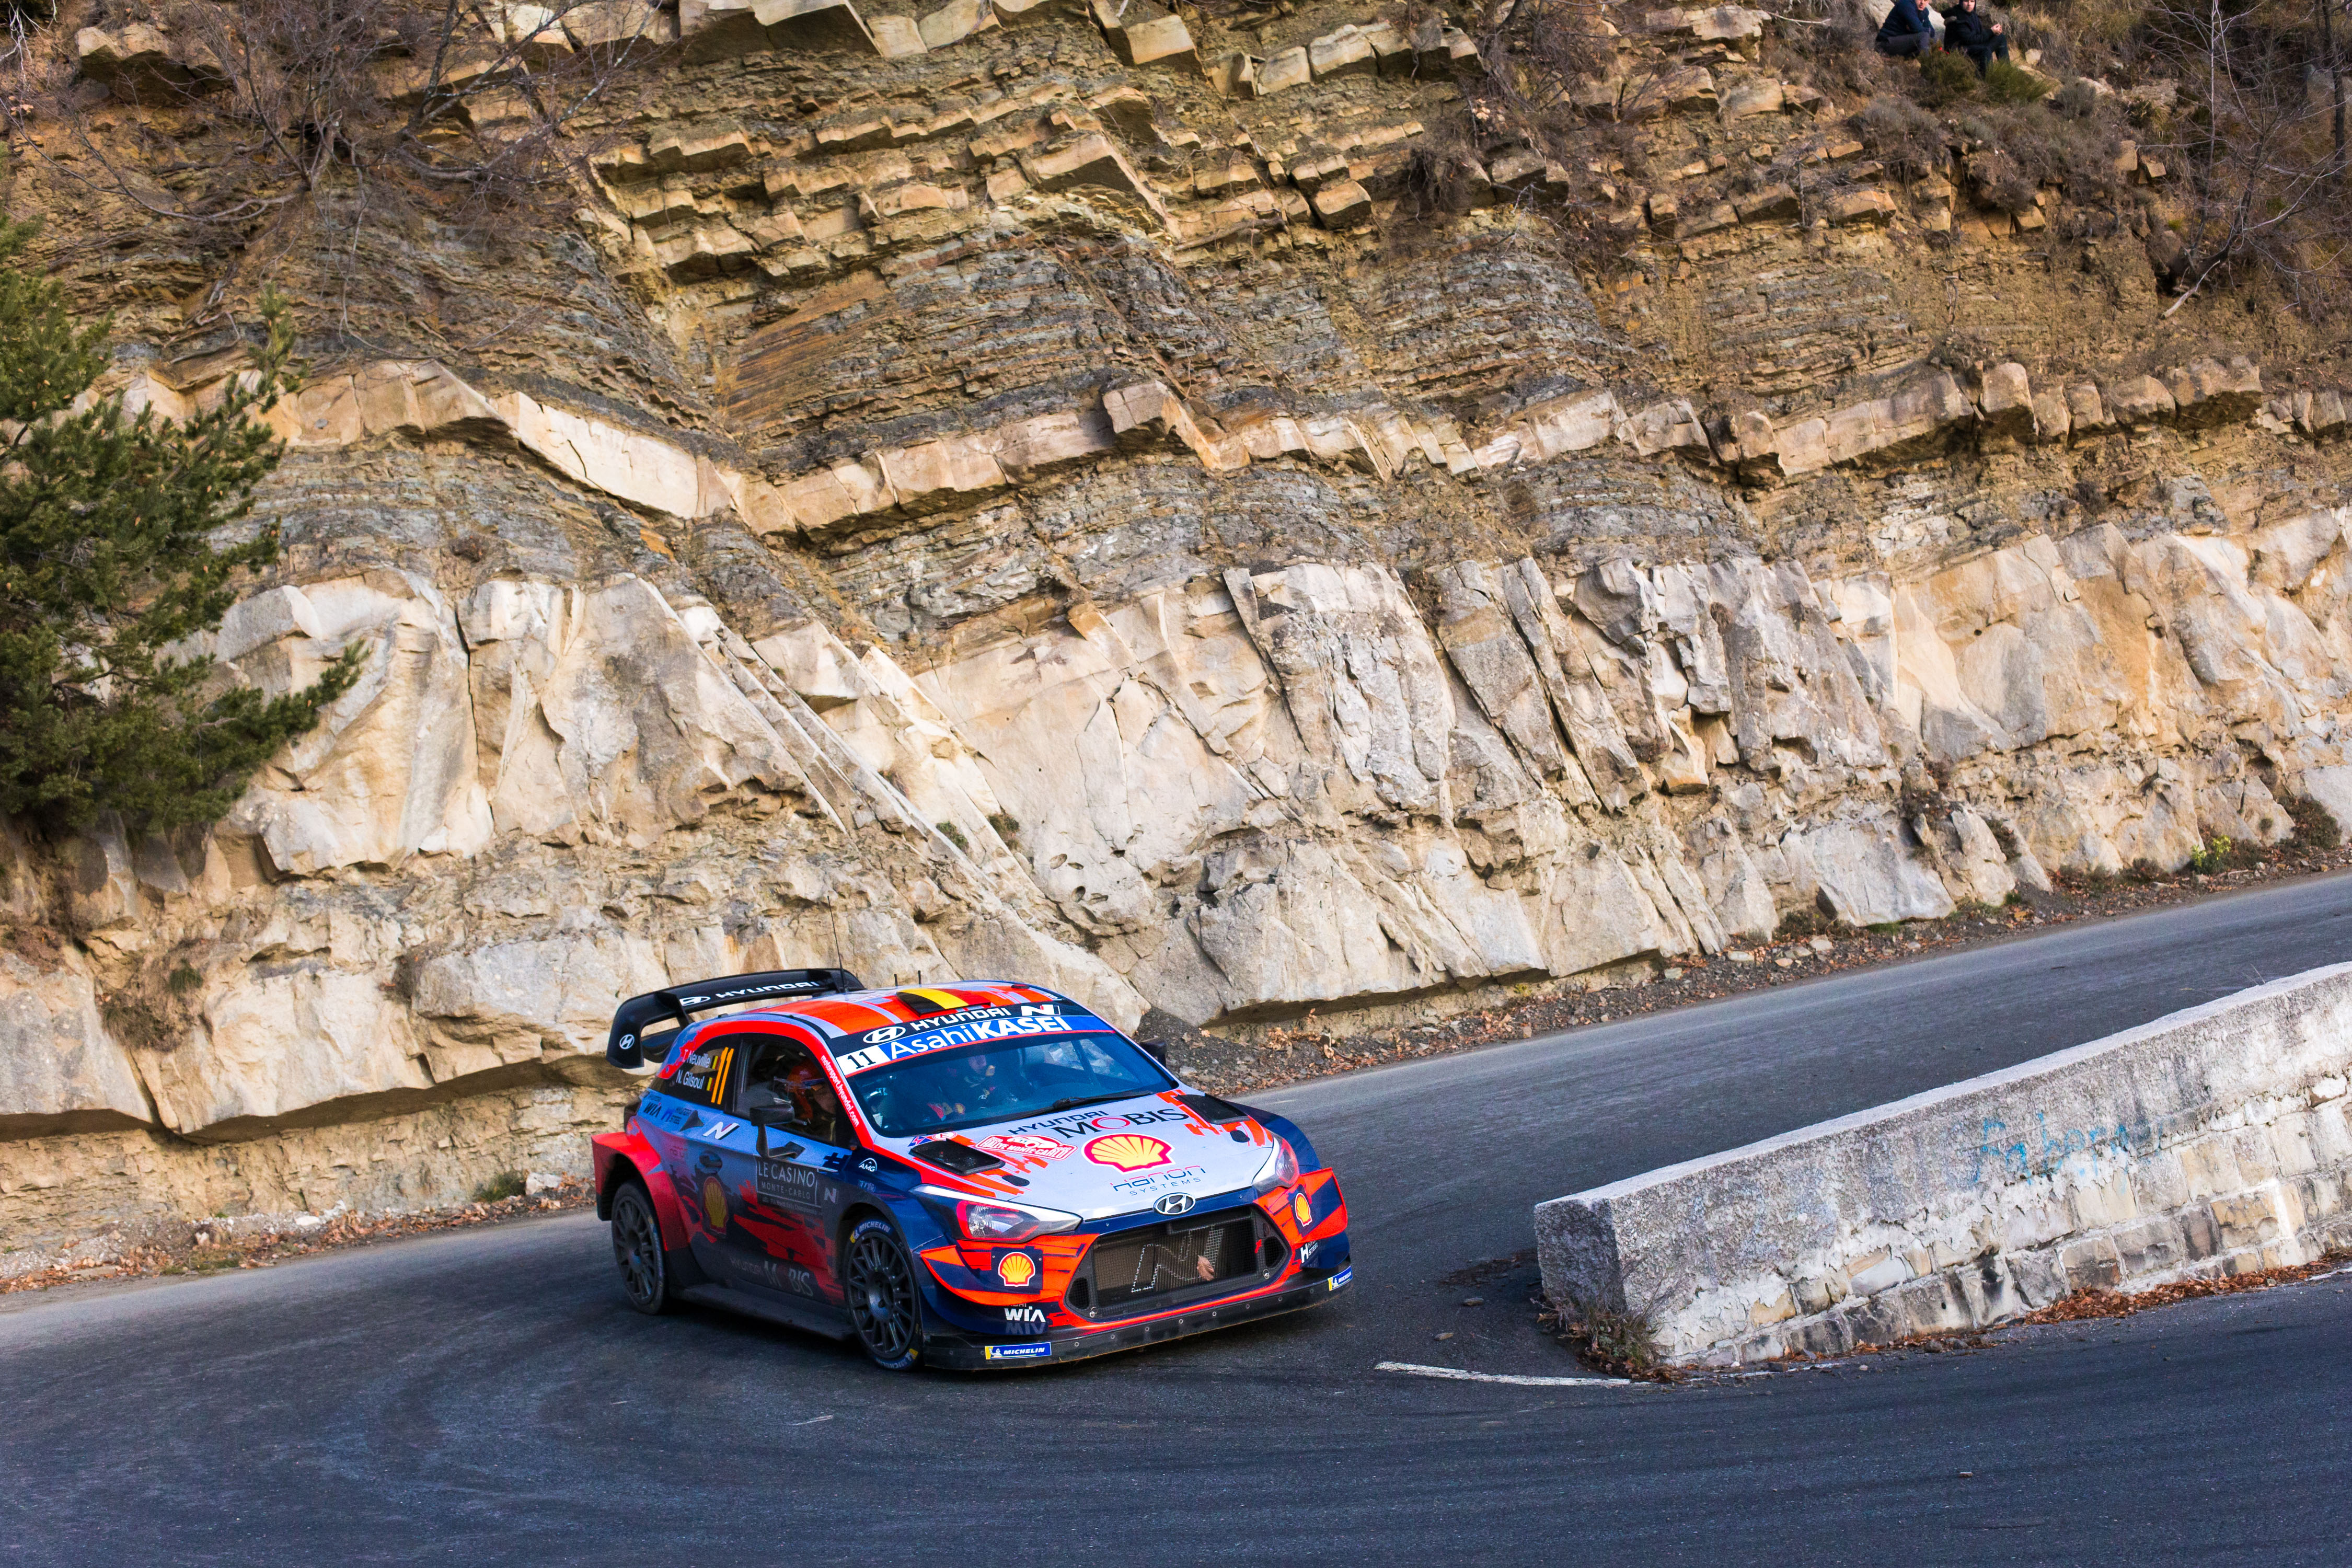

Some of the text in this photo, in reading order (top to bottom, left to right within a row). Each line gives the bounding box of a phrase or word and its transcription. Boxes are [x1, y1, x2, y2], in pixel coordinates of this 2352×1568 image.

[716, 982, 820, 998] HYUNDAI
[910, 1007, 1012, 1031] HYUNDAI
[687, 1051, 710, 1068] Neuville
[847, 1051, 877, 1069] 11
[683, 1071, 705, 1089] Gilsoul
[711, 1047, 734, 1105] 11
[821, 1055, 859, 1127] motorsport.hyundai.com
[1008, 1111, 1109, 1135] HYUNDAI
[1051, 1109, 1190, 1139] MOBIS
[979, 1139, 1068, 1158] RALLYE MONTE-CARLO
[758, 1161, 815, 1187] LE CASINO
[1129, 1177, 1201, 1196] SYSTEMS
[859, 1221, 891, 1233] MICHELIN
